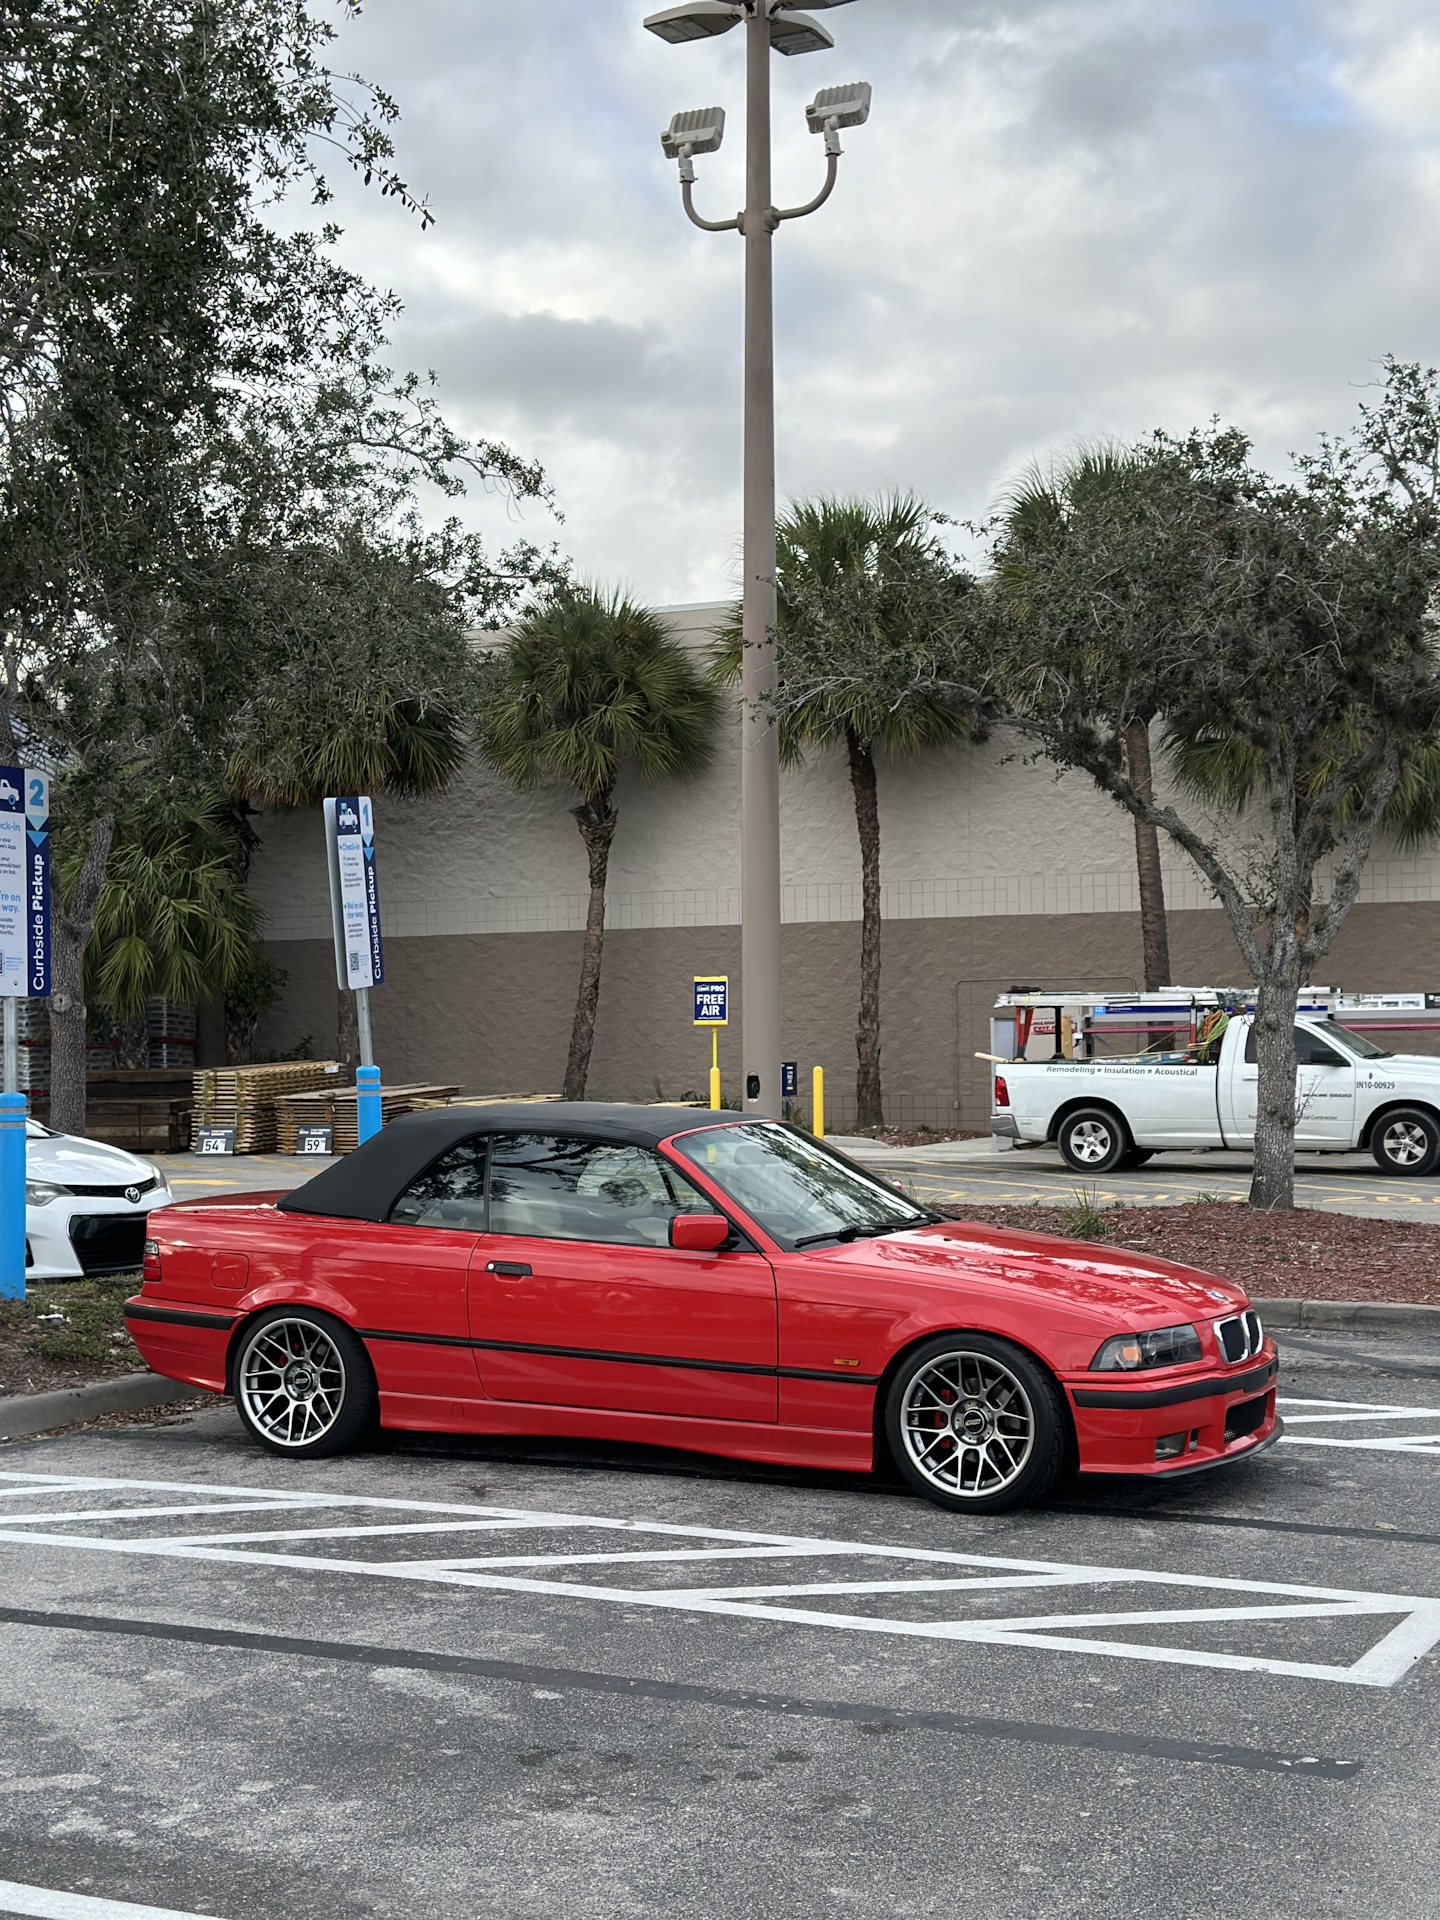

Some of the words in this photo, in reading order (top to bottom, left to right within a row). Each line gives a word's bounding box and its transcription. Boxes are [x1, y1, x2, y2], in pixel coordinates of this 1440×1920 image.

[29, 779, 44, 807] 2
[363, 804, 370, 827] 1
[32, 854, 44, 911] Pickup
[368, 866, 377, 914] Pickup
[33, 914, 44, 990] Curbside
[371, 916, 381, 980] Curbside
[696, 994, 725, 1005] FREE
[701, 1005, 720, 1016] AIR
[1046, 1065, 1096, 1075] Remodeling
[1104, 1066, 1145, 1075] Insulation
[1154, 1067, 1198, 1076] Acoustical
[1356, 1081, 1396, 1090] IN10-00929
[205, 1140, 219, 1151] 54
[307, 1140, 320, 1151] 59
